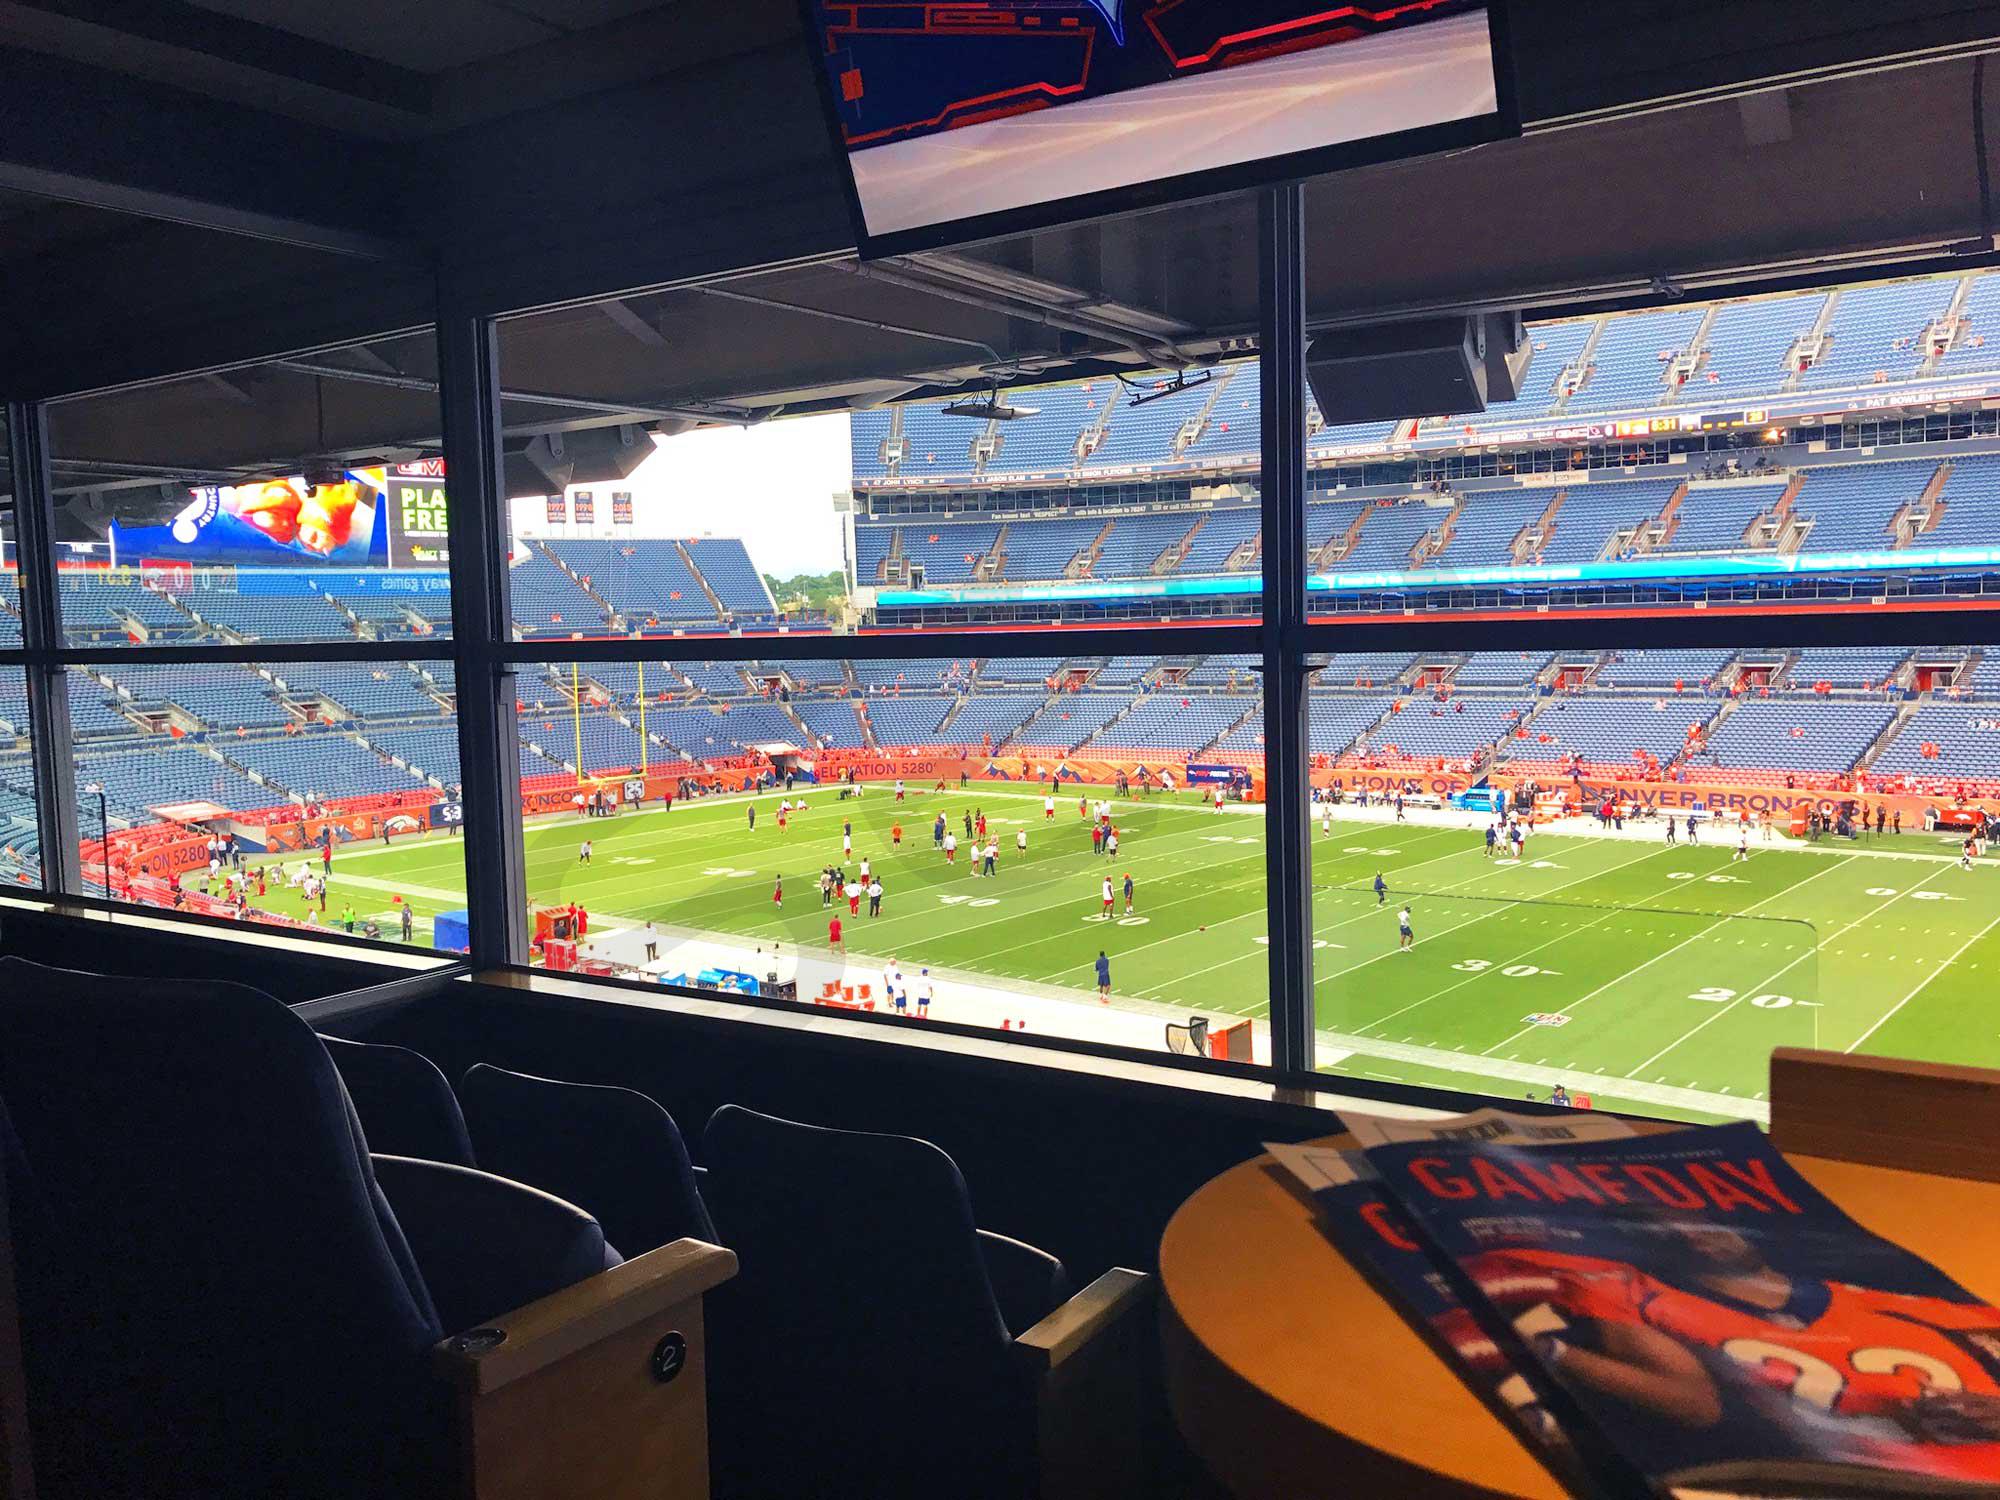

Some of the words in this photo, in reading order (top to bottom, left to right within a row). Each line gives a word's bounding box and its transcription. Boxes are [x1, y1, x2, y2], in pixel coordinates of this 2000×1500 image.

[1866, 398, 1886, 409] PAT
[1889, 393, 1933, 406] BOWLEN
[986, 475, 1007, 483] JASON
[1431, 778, 1466, 793] OF
[174, 844, 206, 867] 5280
[1406, 1157, 1804, 1215] GAMEDAY
[662, 1345, 677, 1372] 2
